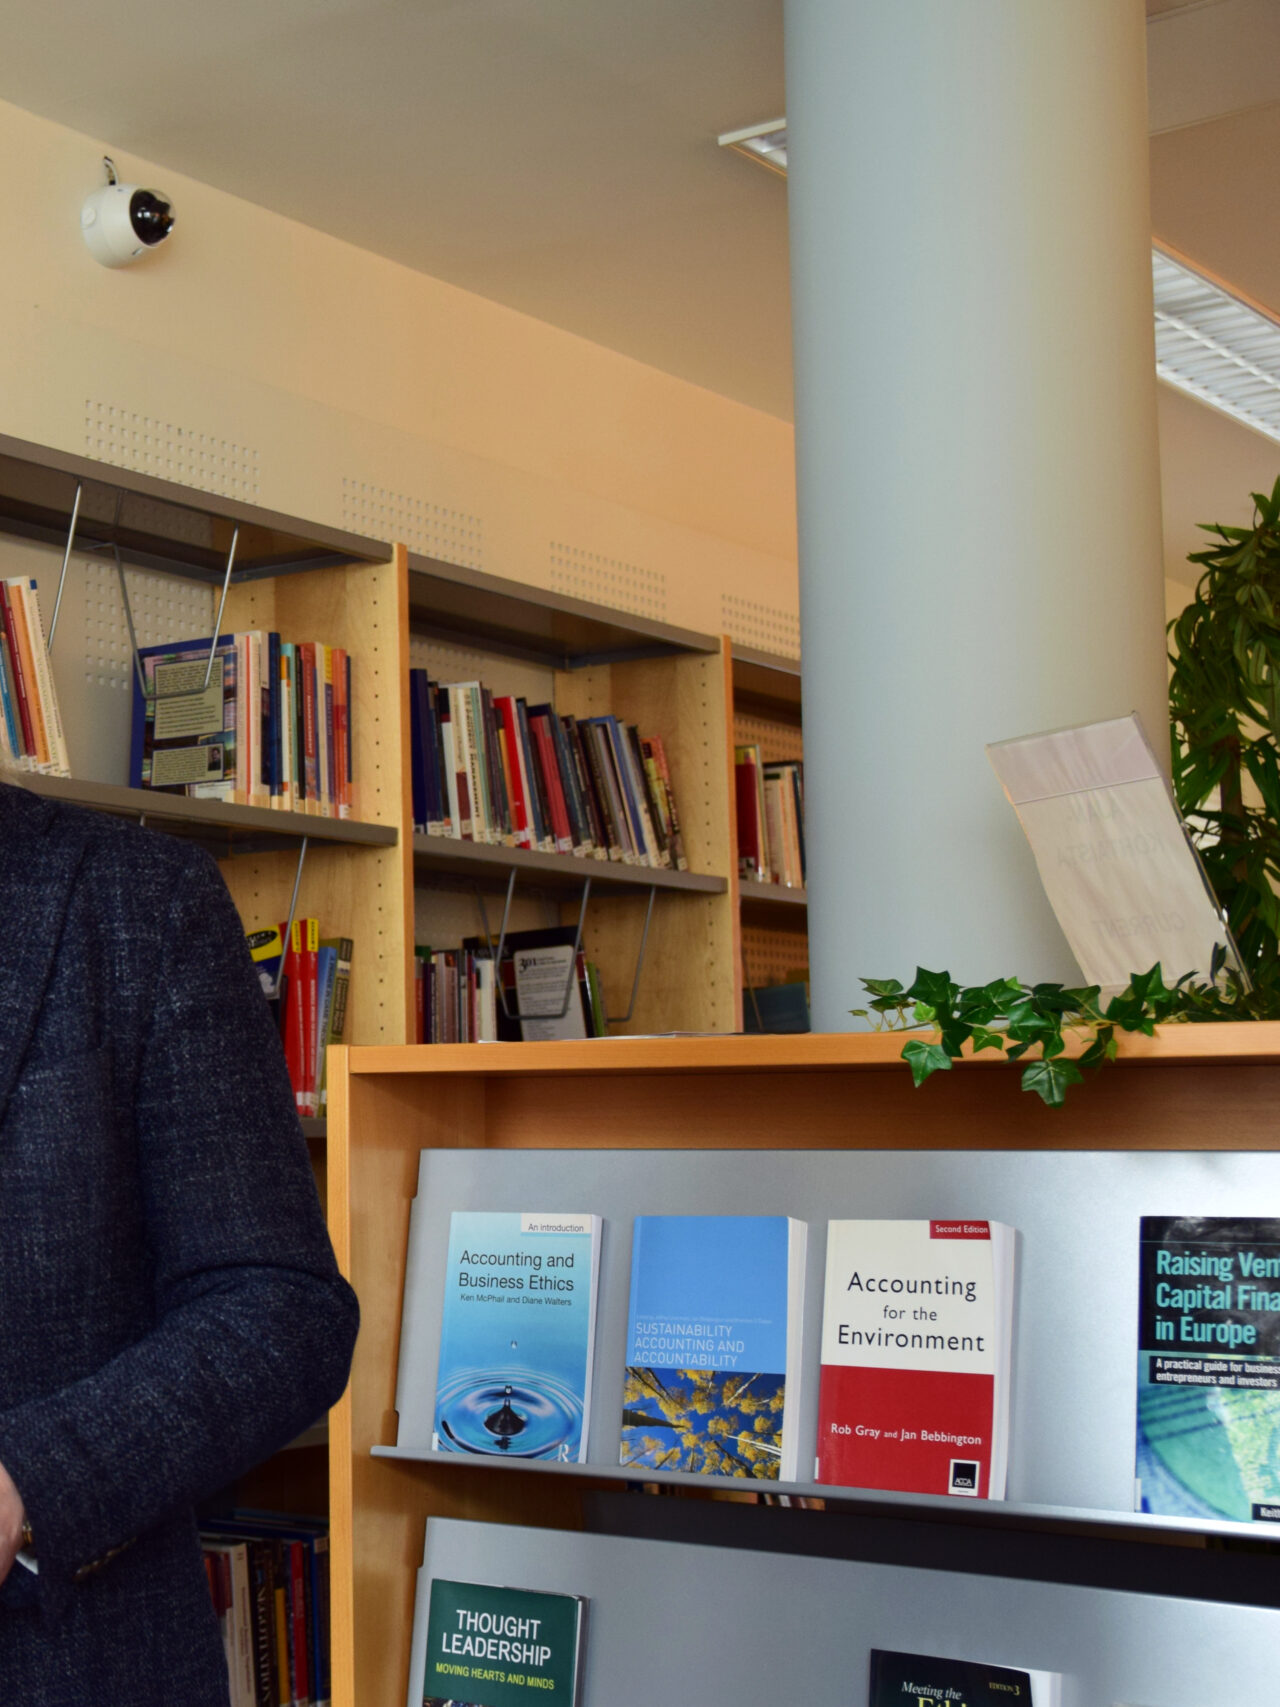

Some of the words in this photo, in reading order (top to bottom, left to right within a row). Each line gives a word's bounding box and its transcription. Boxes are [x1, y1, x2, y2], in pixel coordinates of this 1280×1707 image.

[528, 1223, 538, 1232] An
[541, 1224, 584, 1233] introduction
[935, 1224, 962, 1233] Second
[963, 1225, 988, 1234] Edition
[460, 1250, 542, 1271] Accounting
[547, 1253, 574, 1268] and
[1157, 1250, 1234, 1282] Raising
[459, 1272, 524, 1290] Business
[529, 1274, 574, 1292] Ethics
[847, 1271, 977, 1302] Accounting
[460, 1293, 474, 1301] Ken
[476, 1294, 505, 1303] McPhail
[507, 1296, 520, 1304] and
[522, 1296, 542, 1305] Diane
[1156, 1282, 1231, 1314] Capital
[883, 1305, 906, 1319] for
[913, 1307, 938, 1321] the
[636, 1322, 733, 1337] SUSTAINABILITY
[838, 1324, 985, 1352] Environment
[1156, 1315, 1174, 1341] in
[1180, 1316, 1257, 1349] Europe
[635, 1337, 714, 1352] ACCOUNTING
[717, 1340, 745, 1353] AND
[634, 1351, 738, 1367] ACCOUNTABILITY
[1156, 1358, 1163, 1368] A
[1164, 1359, 1202, 1370] practical
[1204, 1361, 1228, 1372] guide
[1230, 1361, 1243, 1372] for
[1156, 1371, 1217, 1384] entrepreneurs
[1219, 1375, 1236, 1385] and
[1237, 1376, 1278, 1387] investors
[831, 1423, 852, 1435] Rob
[855, 1424, 881, 1439] Gray
[883, 1431, 898, 1439] and
[900, 1429, 917, 1442] Jan
[921, 1430, 982, 1447] Bebbington
[456, 1609, 542, 1641] THOUGHT
[442, 1632, 551, 1666] LEADERSHIP
[436, 1662, 470, 1678] MOVING
[471, 1667, 506, 1683] HEARTS
[507, 1673, 525, 1686] AND
[526, 1676, 555, 1690] MINDS
[901, 1681, 943, 1700] Meeting
[945, 1687, 962, 1700] the
[1014, 1685, 1020, 1696] 3
